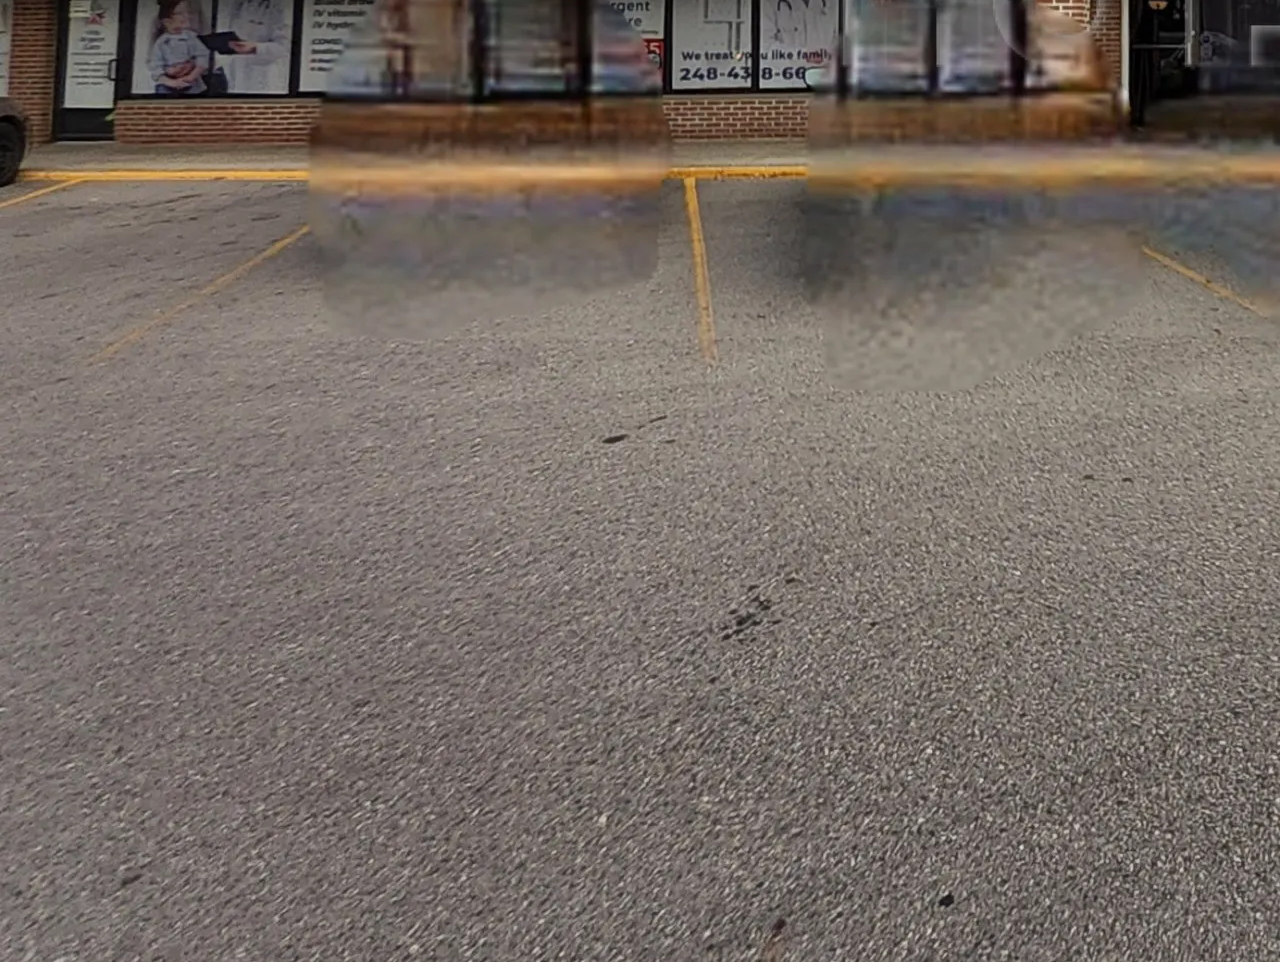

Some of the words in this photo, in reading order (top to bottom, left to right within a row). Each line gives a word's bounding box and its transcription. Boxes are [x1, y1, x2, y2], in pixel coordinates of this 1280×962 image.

[611, 1, 651, 13] rgent
[627, 16, 643, 27] re
[681, 51, 701, 61] We
[705, 50, 734, 61] treat
[772, 49, 794, 60] like
